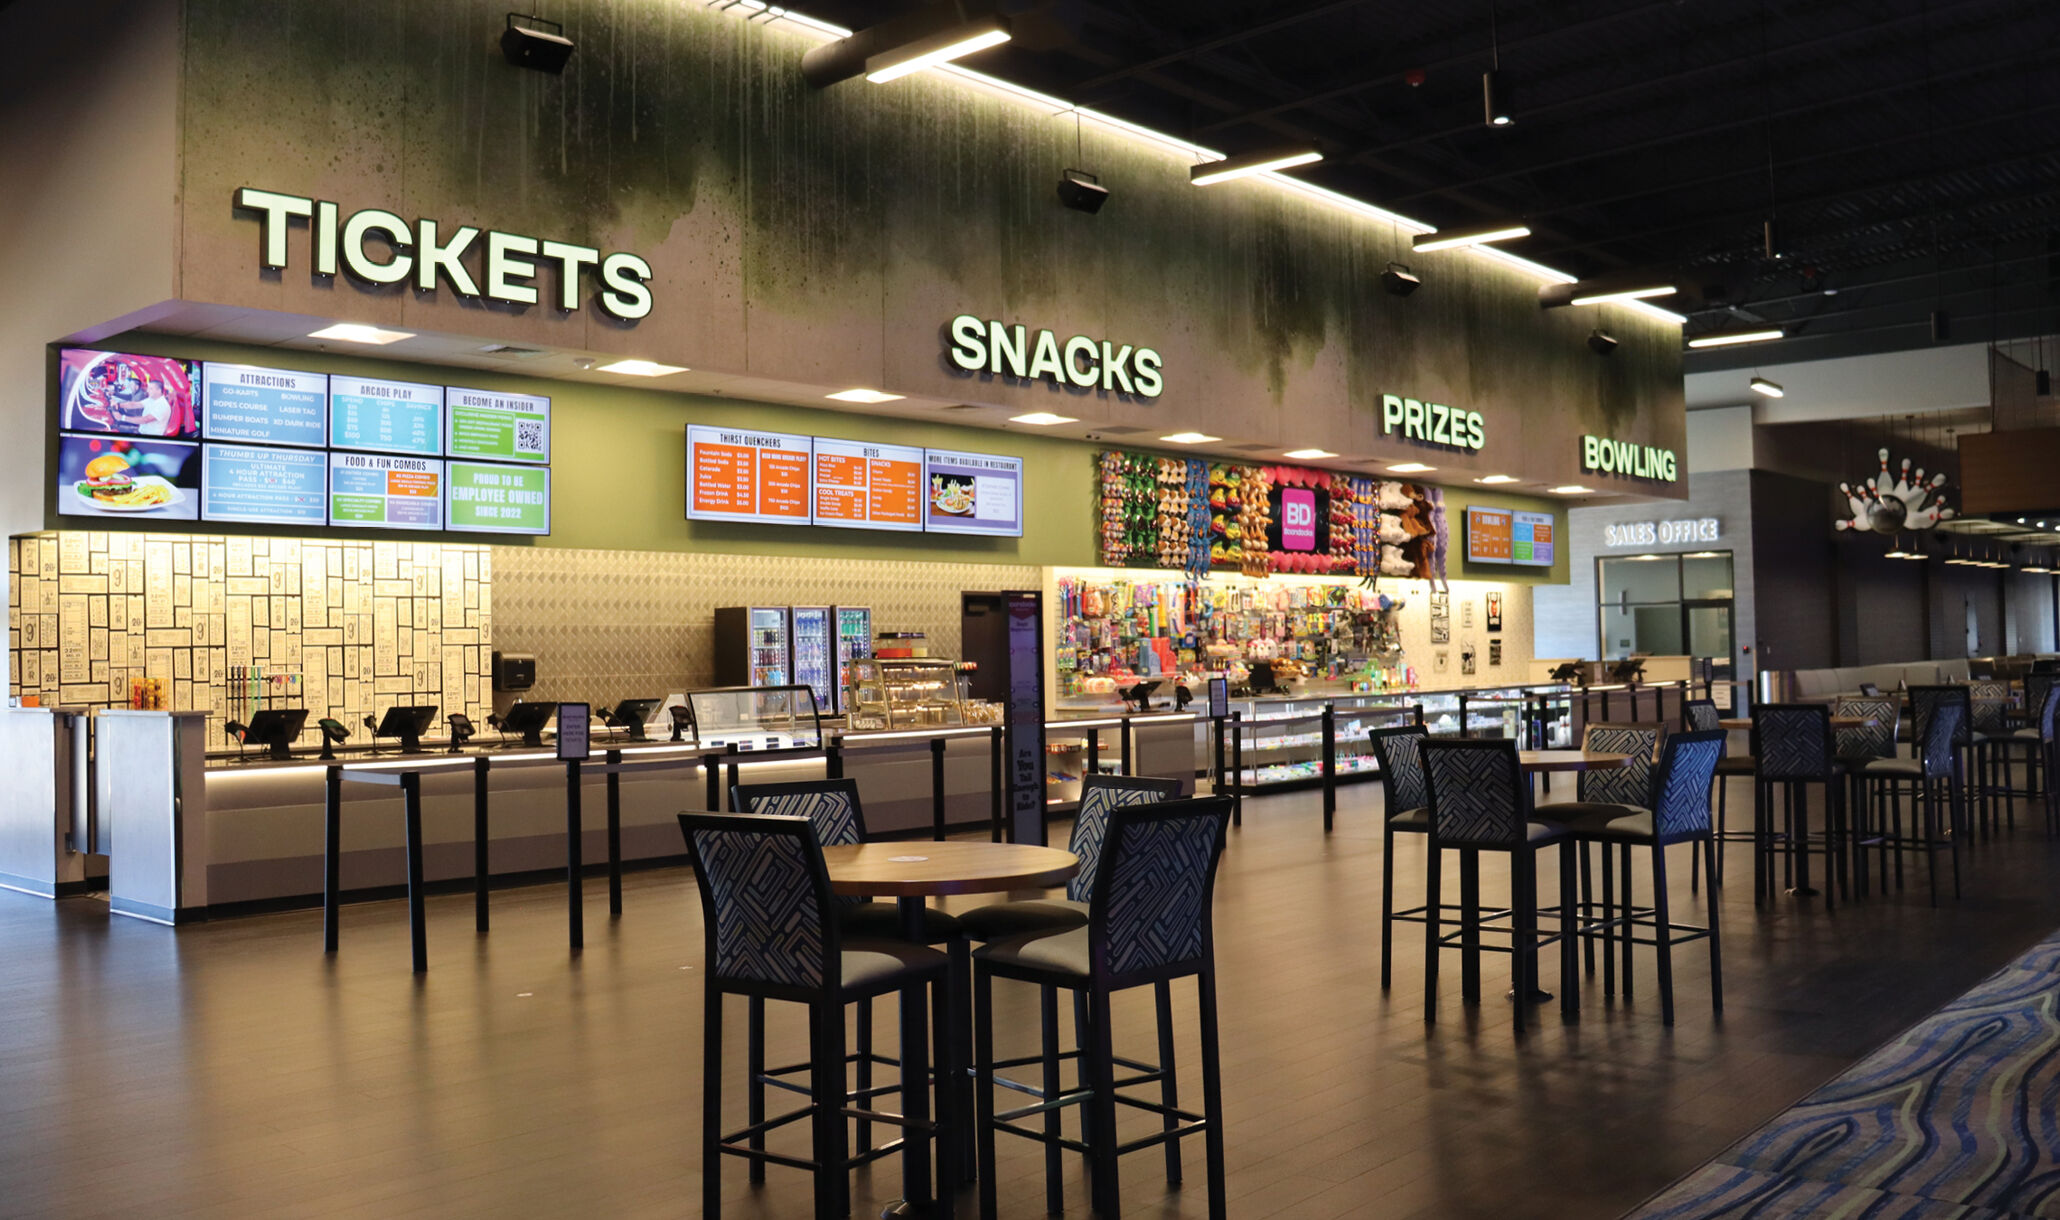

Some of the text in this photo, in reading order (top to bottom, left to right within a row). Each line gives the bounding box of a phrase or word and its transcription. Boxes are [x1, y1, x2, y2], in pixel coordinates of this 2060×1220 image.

[235, 187, 653, 320] TICKETS
[950, 314, 1163, 398] SNACKS
[240, 374, 296, 389] ATTRACTIONS
[223, 387, 259, 397] GO-KARTS
[281, 393, 314, 402] BOWLING
[360, 385, 413, 400] ARCADE PLAY
[213, 400, 268, 411] ROPES COURSE
[463, 396, 534, 411] BECOME AN INSIDER
[280, 406, 316, 416] LASER TAG
[212, 413, 268, 424] BUMPER BOATS
[285, 419, 303, 427] DARK
[305, 421, 320, 429] RIDE
[1382, 393, 1485, 450] PRIZES
[211, 426, 249, 436] MINIATURE
[720, 433, 781, 448] THIRST QUENCHERS
[219, 449, 315, 463] THUMBS UP THURSDAY
[830, 456, 846, 464] BITES
[863, 448, 880, 458] BITES
[1583, 434, 1677, 482] BOWLING
[250, 463, 286, 471] ULTIMATE
[345, 456, 426, 471] FOOD & FUN COMBOS
[929, 455, 942, 463] MORE
[943, 456, 958, 464] ITEMS
[960, 458, 983, 467] AVAILABLE
[990, 461, 1017, 470] RESTAURANT
[259, 471, 304, 479] ATTRACTION
[473, 472, 524, 487] PROUD TO BE
[452, 486, 506, 503] EMPLOYEE
[508, 490, 543, 505] OWNED
[475, 505, 522, 519] SINCE 2022
[1287, 502, 1311, 525] BD
[1605, 518, 1719, 546] SALES OFFICE
[1017, 760, 1034, 771] You
